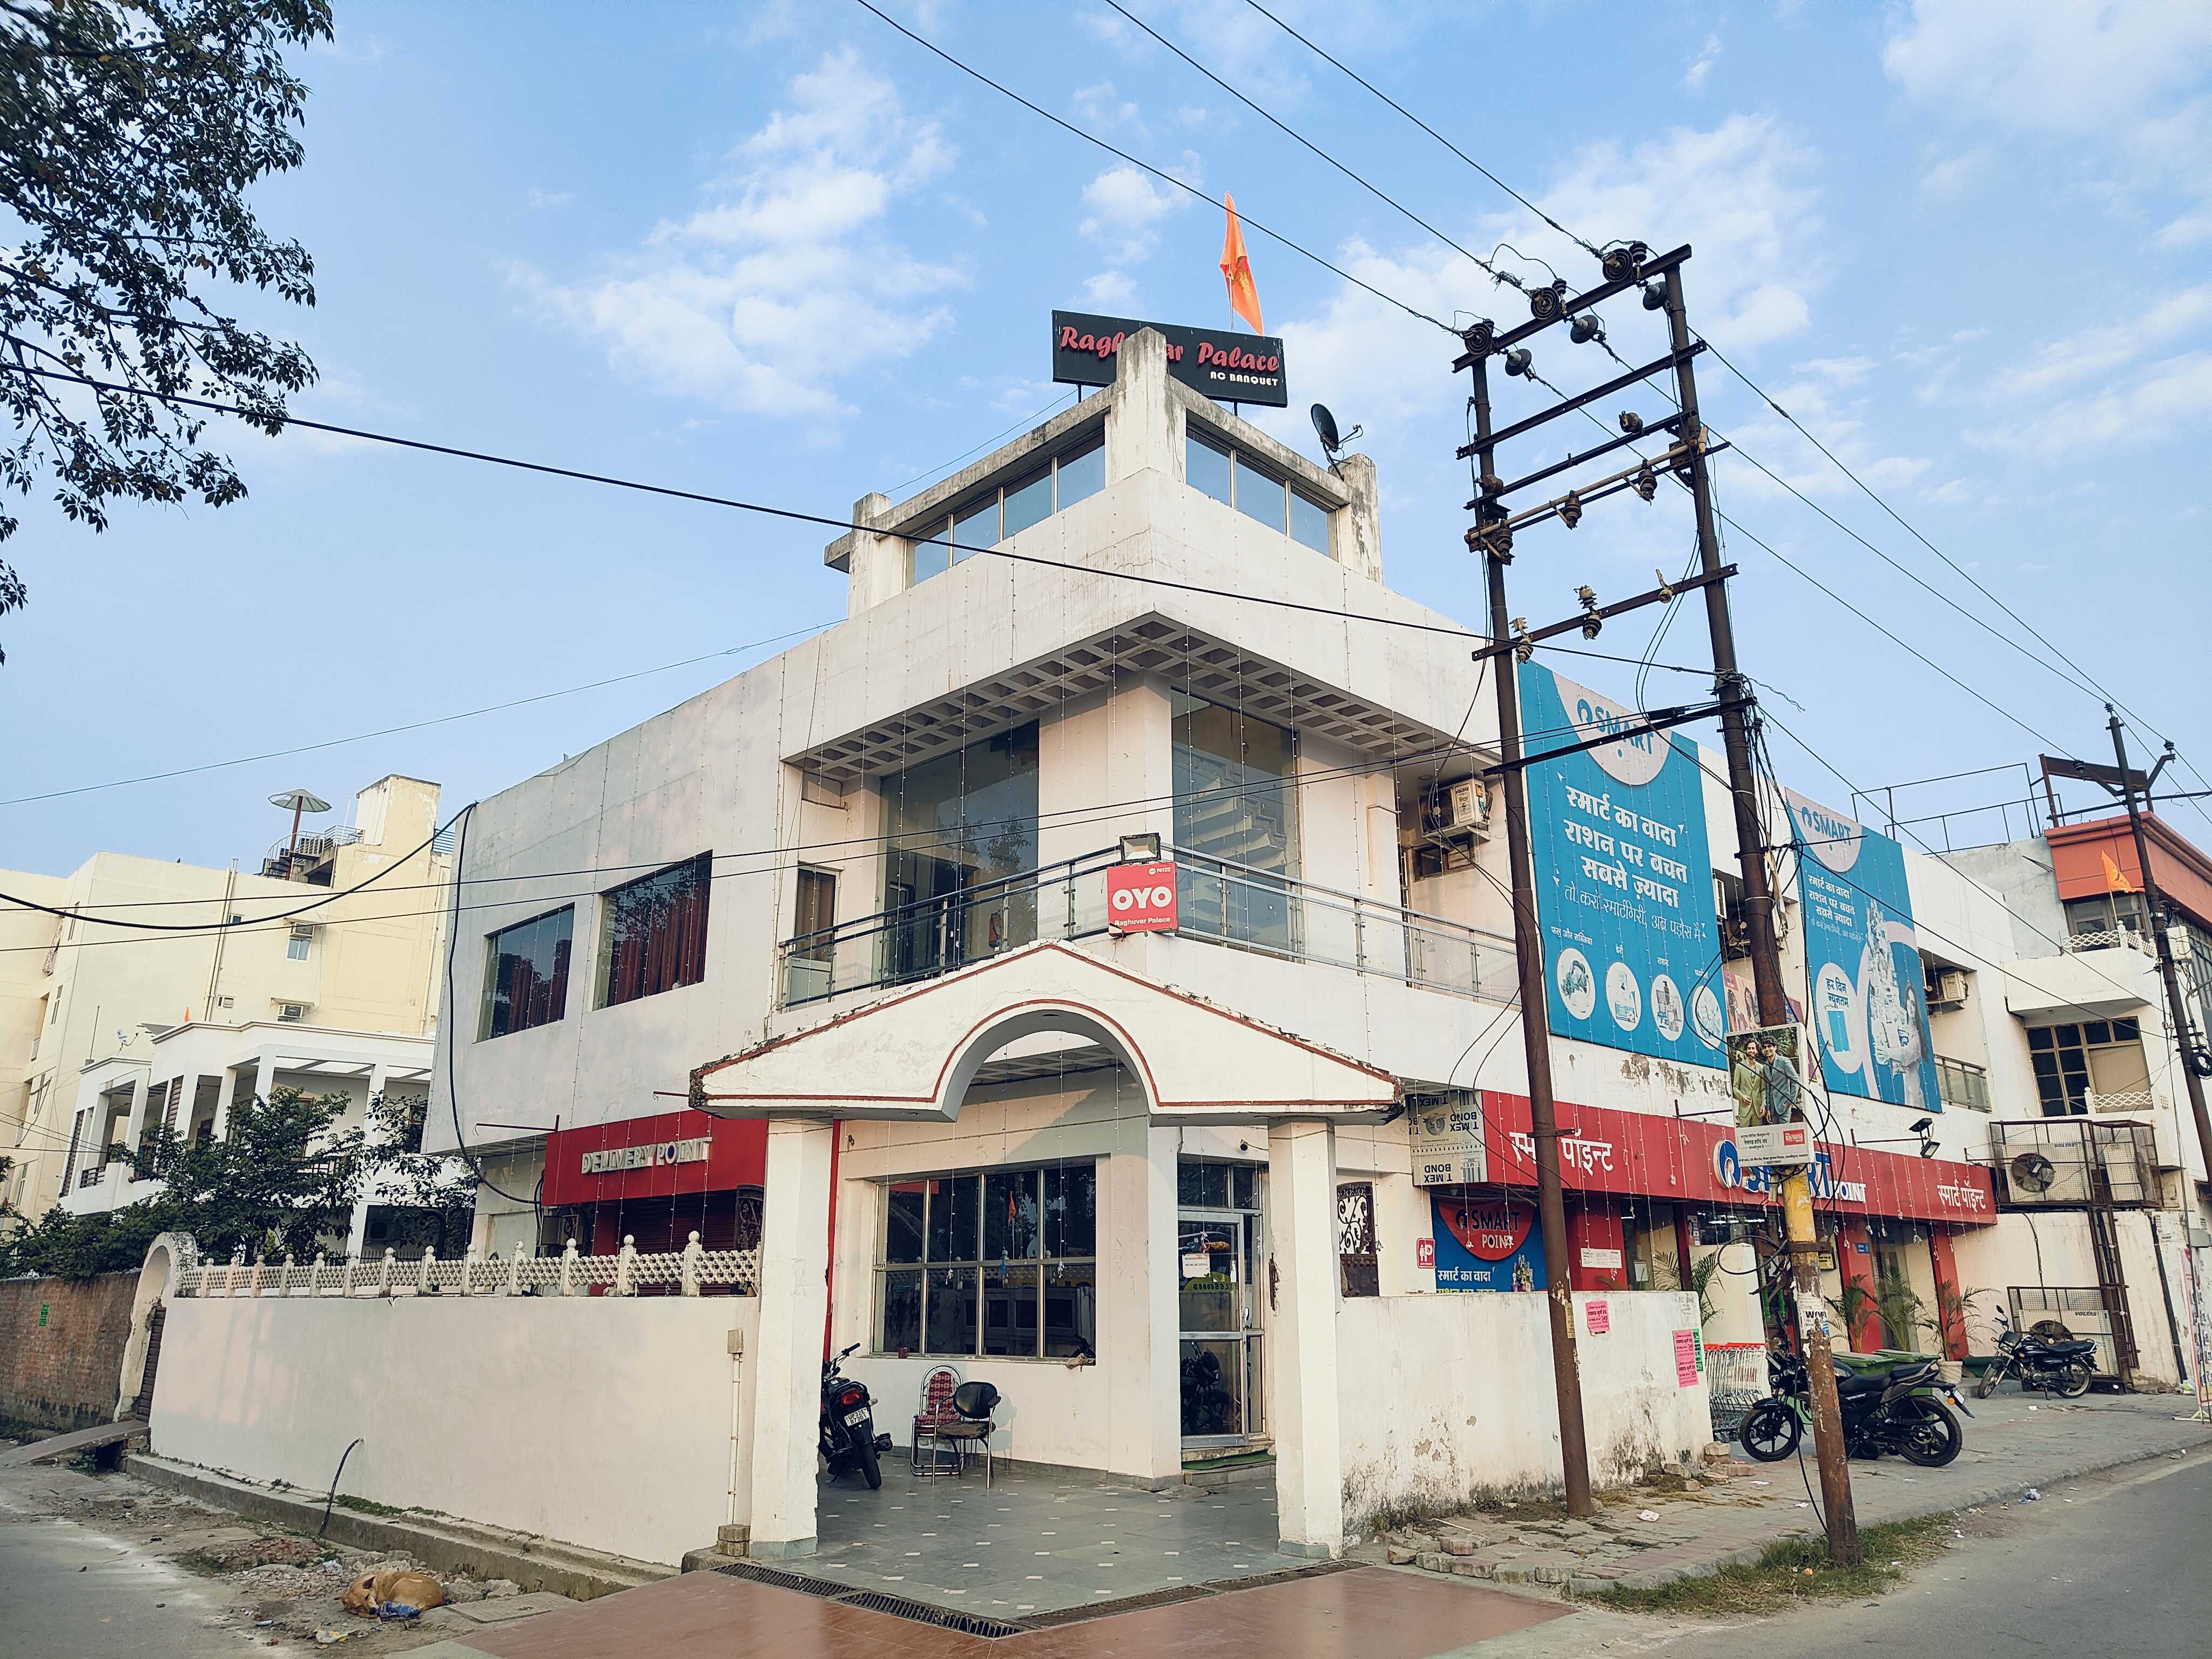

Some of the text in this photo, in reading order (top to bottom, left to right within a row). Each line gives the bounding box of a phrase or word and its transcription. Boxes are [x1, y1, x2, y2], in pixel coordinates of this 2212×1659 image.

[1197, 342, 1279, 372] Palace
[1230, 373, 1279, 387] BANQUET
[1566, 785, 1677, 847] स्मार्ट का वादा
[1813, 811, 1851, 846] SMART
[1563, 819, 1688, 884] राशन पर बचत
[1581, 855, 1628, 891] सबसे
[1808, 874, 1850, 899] स्मार्ट का वादा
[1112, 886, 1172, 911] OYO
[1564, 881, 1576, 902] तो
[1651, 915, 1667, 932] अब
[1808, 889, 1854, 915] राशन पर बचत
[1114, 918, 1147, 926] Raghuvar
[1815, 905, 1833, 920] सबसे
[1825, 976, 1847, 993] हर दिन
[1827, 992, 1849, 1009] न्यूनतम
[1450, 1112, 1477, 1122] BOND
[582, 1137, 712, 1174] DELIVERY POINT
[1561, 1128, 1614, 1176] पॉइन्ट
[1424, 1163, 1451, 1173] BOND
[1834, 1180, 1866, 1202] POINT
[1937, 1179, 1986, 1213] स्मार्ट पॉइन्ट
[1471, 1209, 1521, 1231] SMART
[1438, 1266, 1491, 1282] स्मार्ट का वादा
[848, 1409, 865, 1420] UP32E
[850, 1414, 867, 1424] B7301
